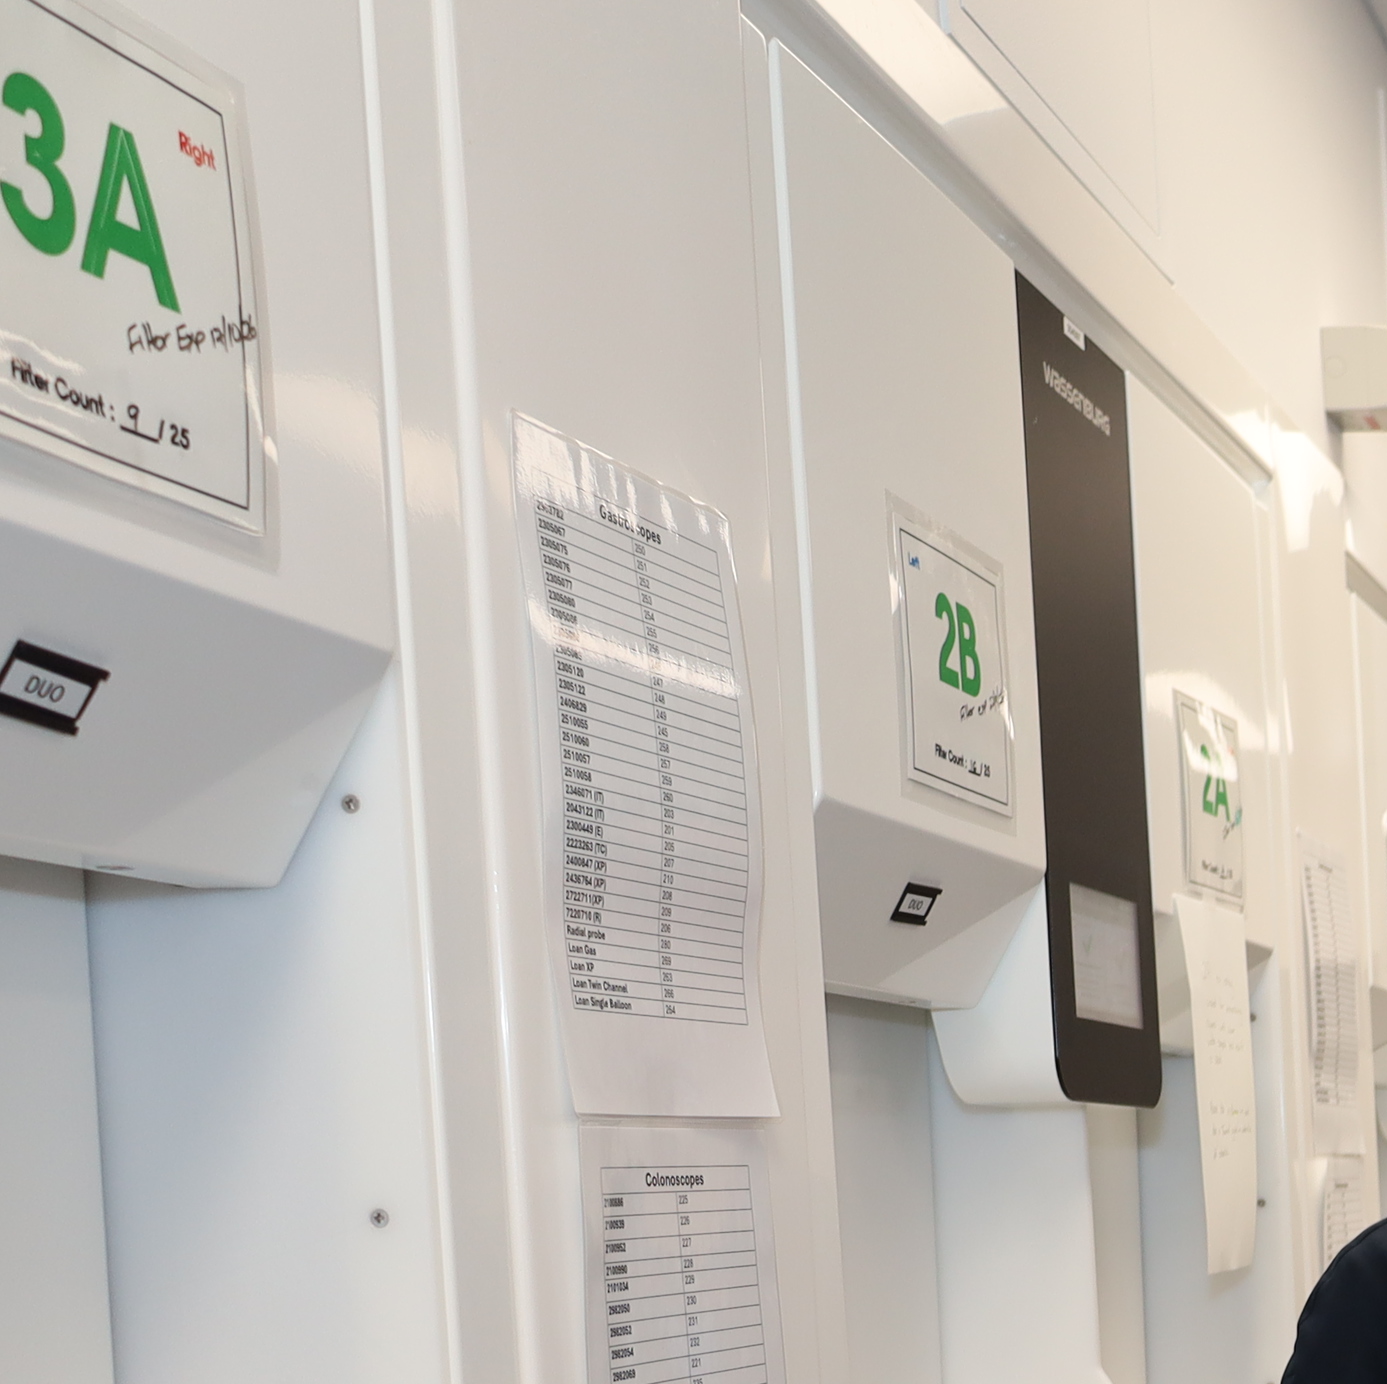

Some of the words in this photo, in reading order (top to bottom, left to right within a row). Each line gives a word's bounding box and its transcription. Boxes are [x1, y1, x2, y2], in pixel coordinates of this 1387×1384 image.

[178, 130, 217, 171] Right
[1, 72, 181, 314] 3A
[600, 504, 661, 545] Gastroopes
[634, 543, 646, 556] 250
[636, 559, 648, 572] 251
[935, 592, 981, 698] 2B
[653, 676, 663, 688] 247
[24, 675, 66, 703] DUO
[657, 725, 668, 738] 245
[660, 758, 671, 770] 257
[664, 808, 674, 819] 203
[664, 824, 674, 836] 201
[664, 857, 674, 868] 207
[663, 874, 674, 885] 210
[566, 925, 586, 935] Radial
[588, 929, 606, 940] probe
[568, 942, 583, 951] Loan
[584, 944, 597, 956] Gas
[570, 960, 585, 971] Loan
[586, 962, 594, 972] XP
[572, 977, 588, 988] Loan
[588, 979, 602, 990] Twin
[603, 981, 628, 993] Channel
[575, 995, 590, 1005] Loan
[590, 997, 608, 1010] Single
[609, 999, 632, 1010] Balloon
[645, 1172, 704, 1188] Colonoscopes
